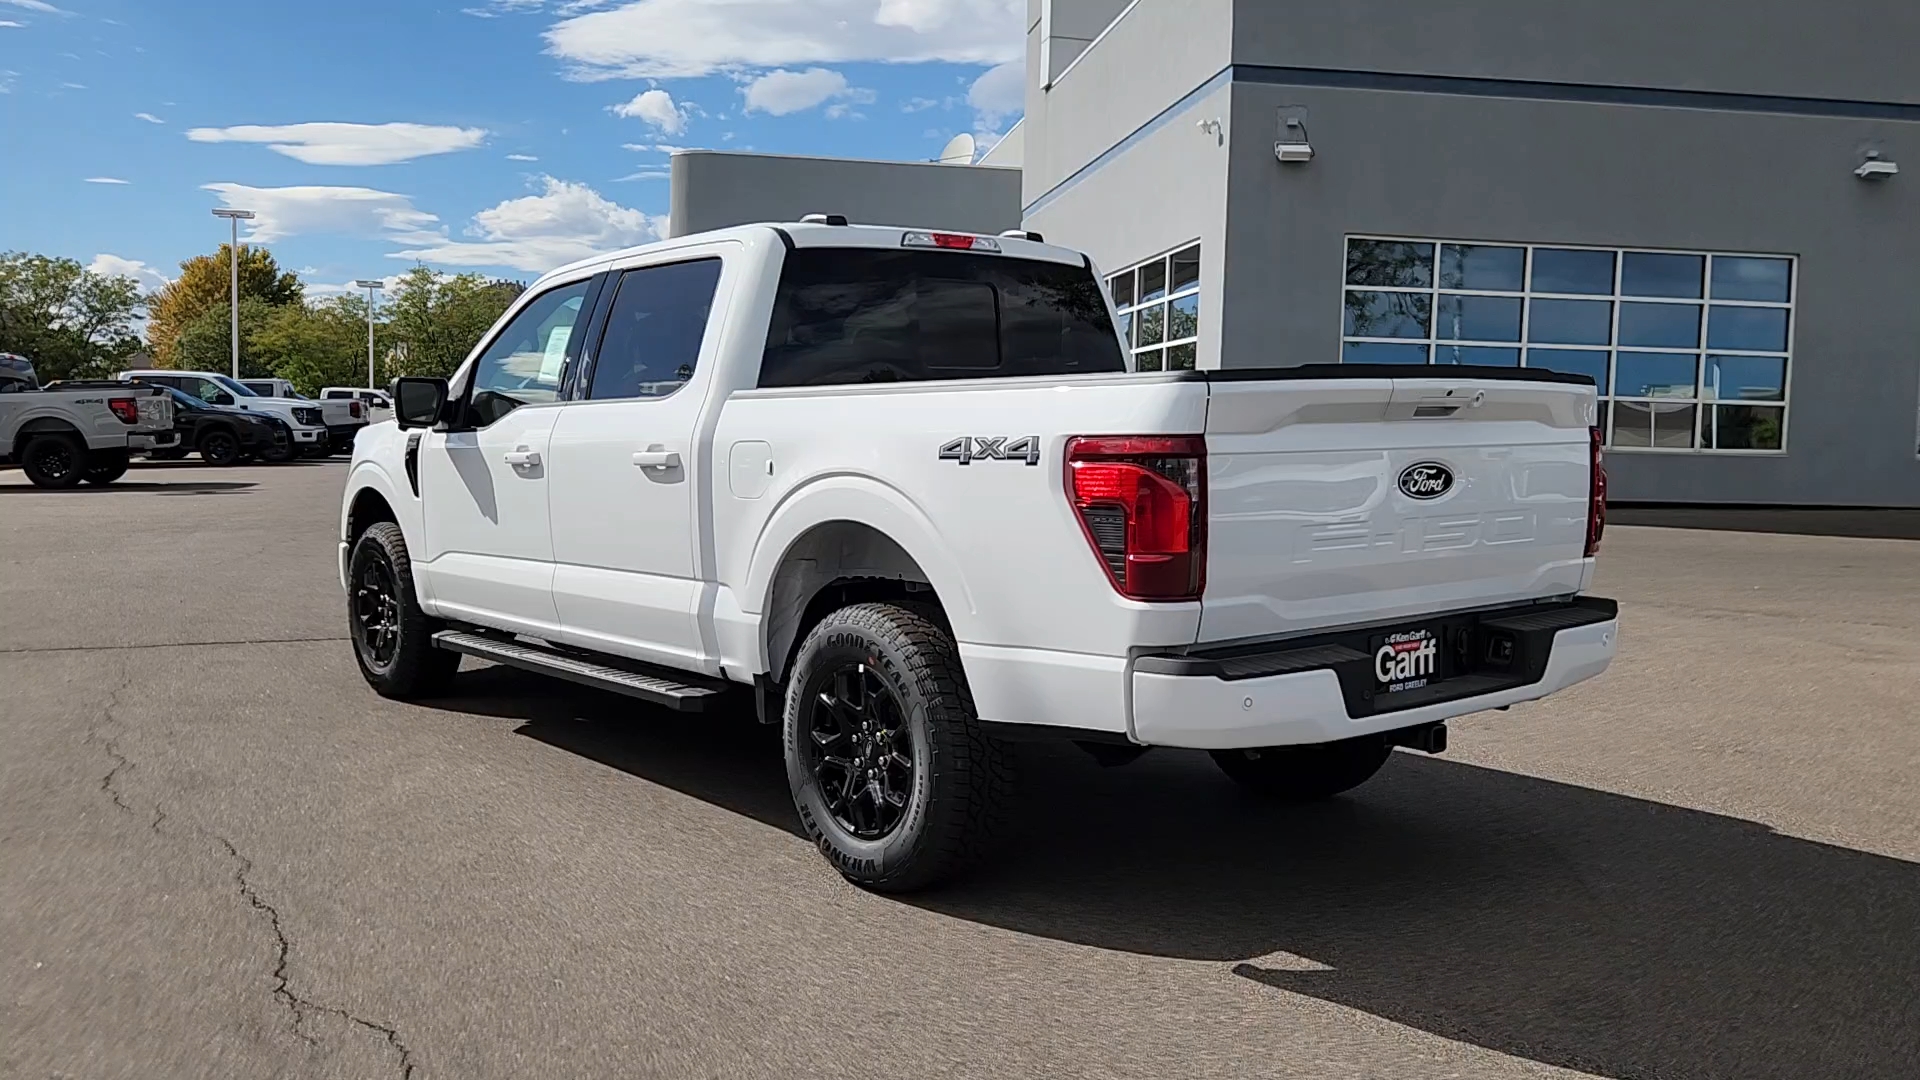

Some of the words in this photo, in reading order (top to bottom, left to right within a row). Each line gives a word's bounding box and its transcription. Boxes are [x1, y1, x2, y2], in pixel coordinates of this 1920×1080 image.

[938, 435, 1040, 466] 4X4
[1409, 467, 1446, 493] Ford
[1396, 633, 1409, 642] Ken
[1409, 629, 1426, 641] Garff
[1375, 637, 1436, 683] Garff
[1389, 683, 1404, 693] FORD
[1404, 678, 1427, 690] GREELEY
[800, 803, 877, 873] WRANGLER
